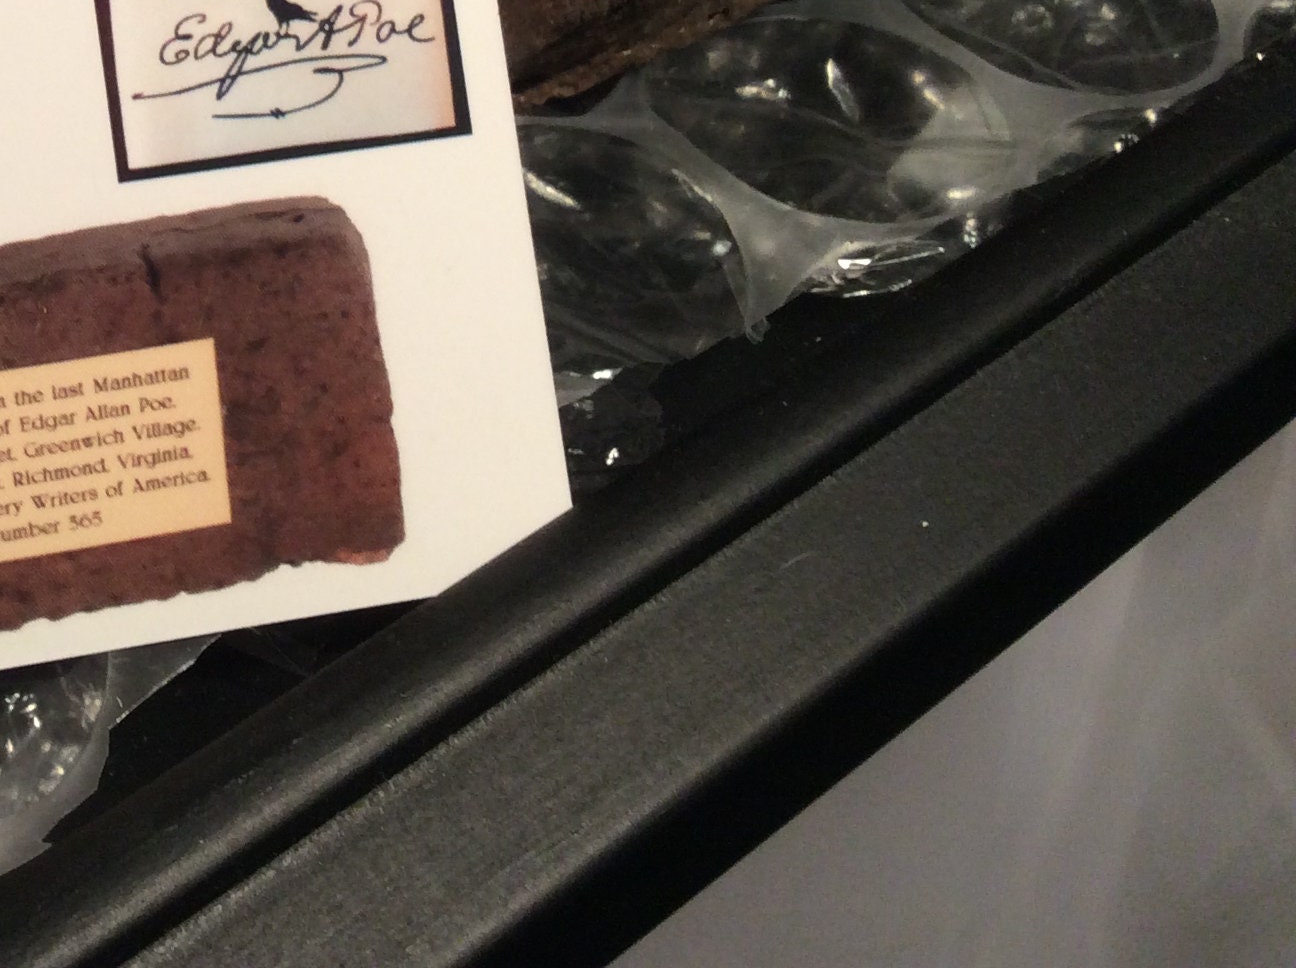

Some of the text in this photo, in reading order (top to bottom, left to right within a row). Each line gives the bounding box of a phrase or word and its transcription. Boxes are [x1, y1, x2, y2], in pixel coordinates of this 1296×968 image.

[14, 390, 44, 406] the
[51, 382, 85, 401] last
[93, 366, 191, 394] Manhattan
[19, 411, 77, 433] Edgar
[85, 403, 131, 422] Allan
[23, 429, 125, 458] Greenwich
[30, 488, 99, 509] Writers
[105, 480, 124, 498] of
[69, 510, 103, 531] 365
